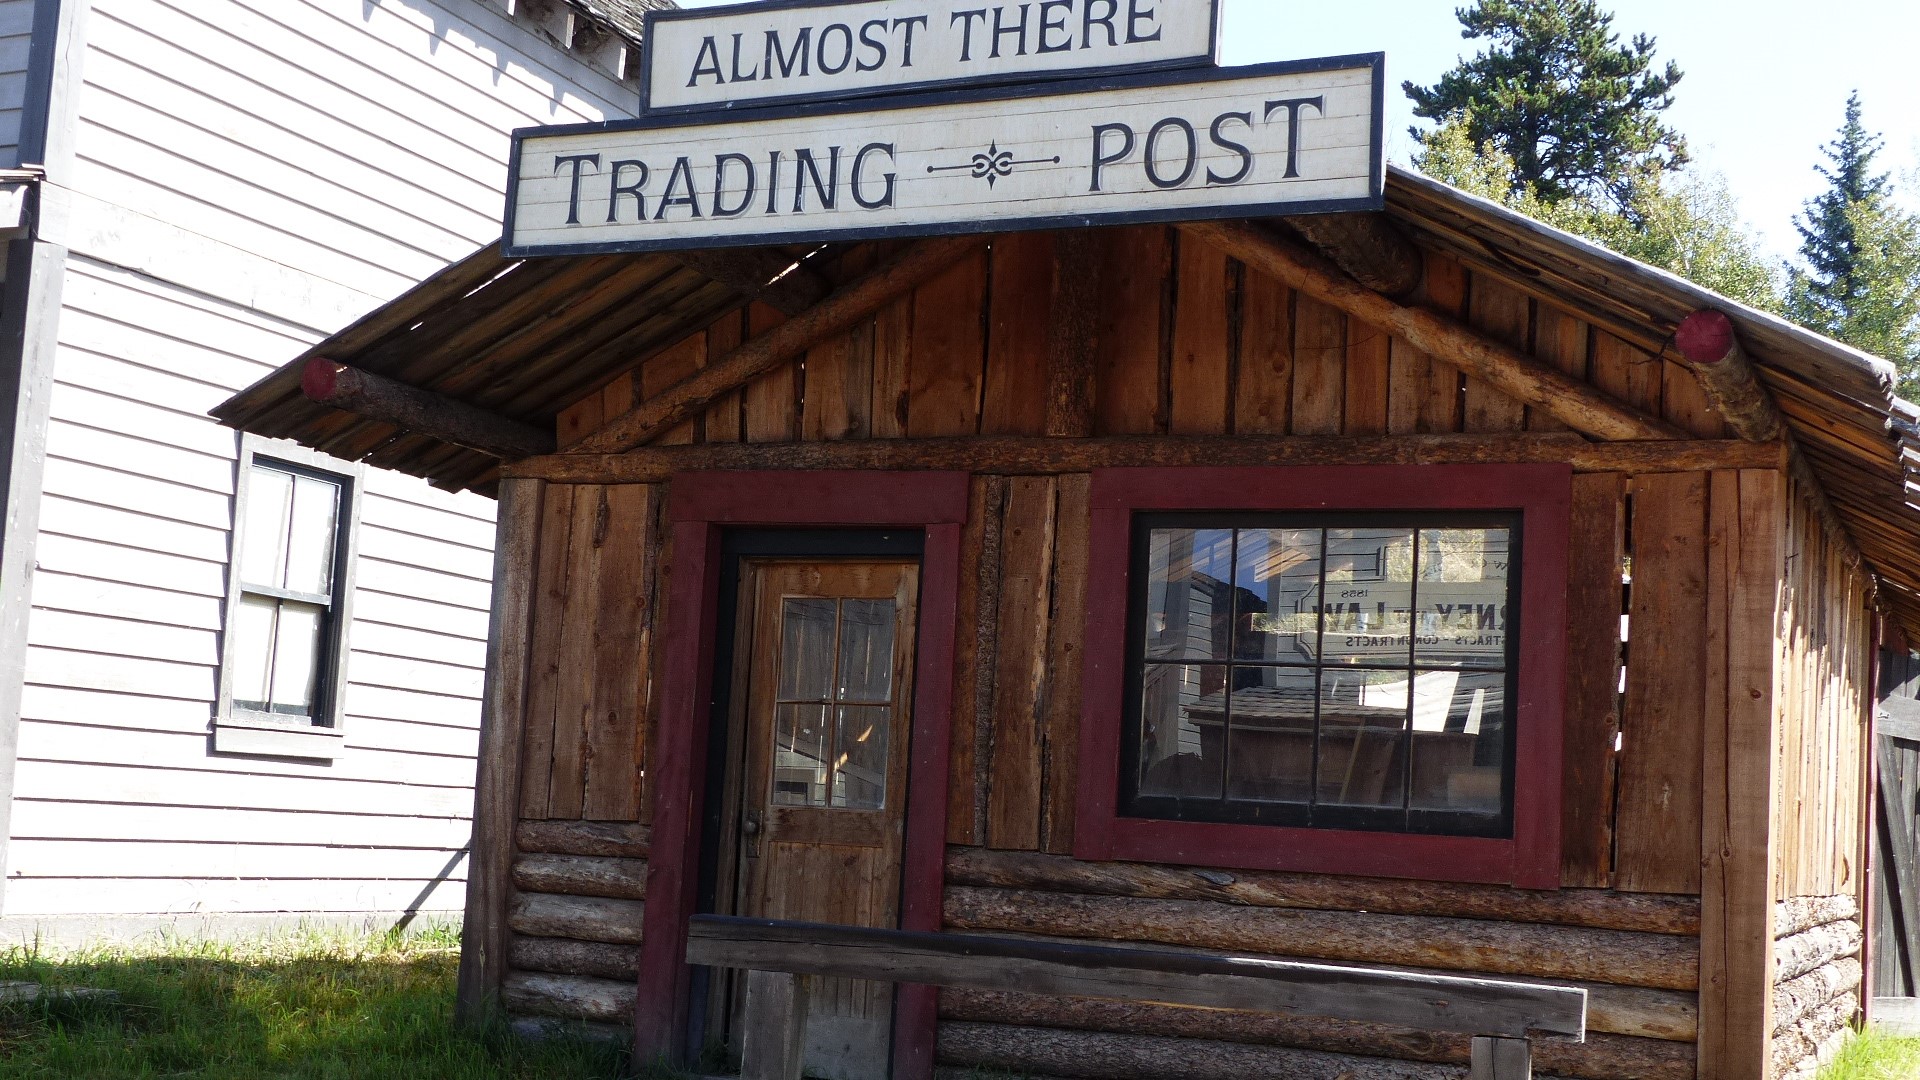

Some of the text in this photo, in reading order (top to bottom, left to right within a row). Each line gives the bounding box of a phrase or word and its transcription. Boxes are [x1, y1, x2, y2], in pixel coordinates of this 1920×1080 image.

[685, 0, 1162, 88] ALMOST THERE
[554, 95, 1325, 226] TRADING POST
